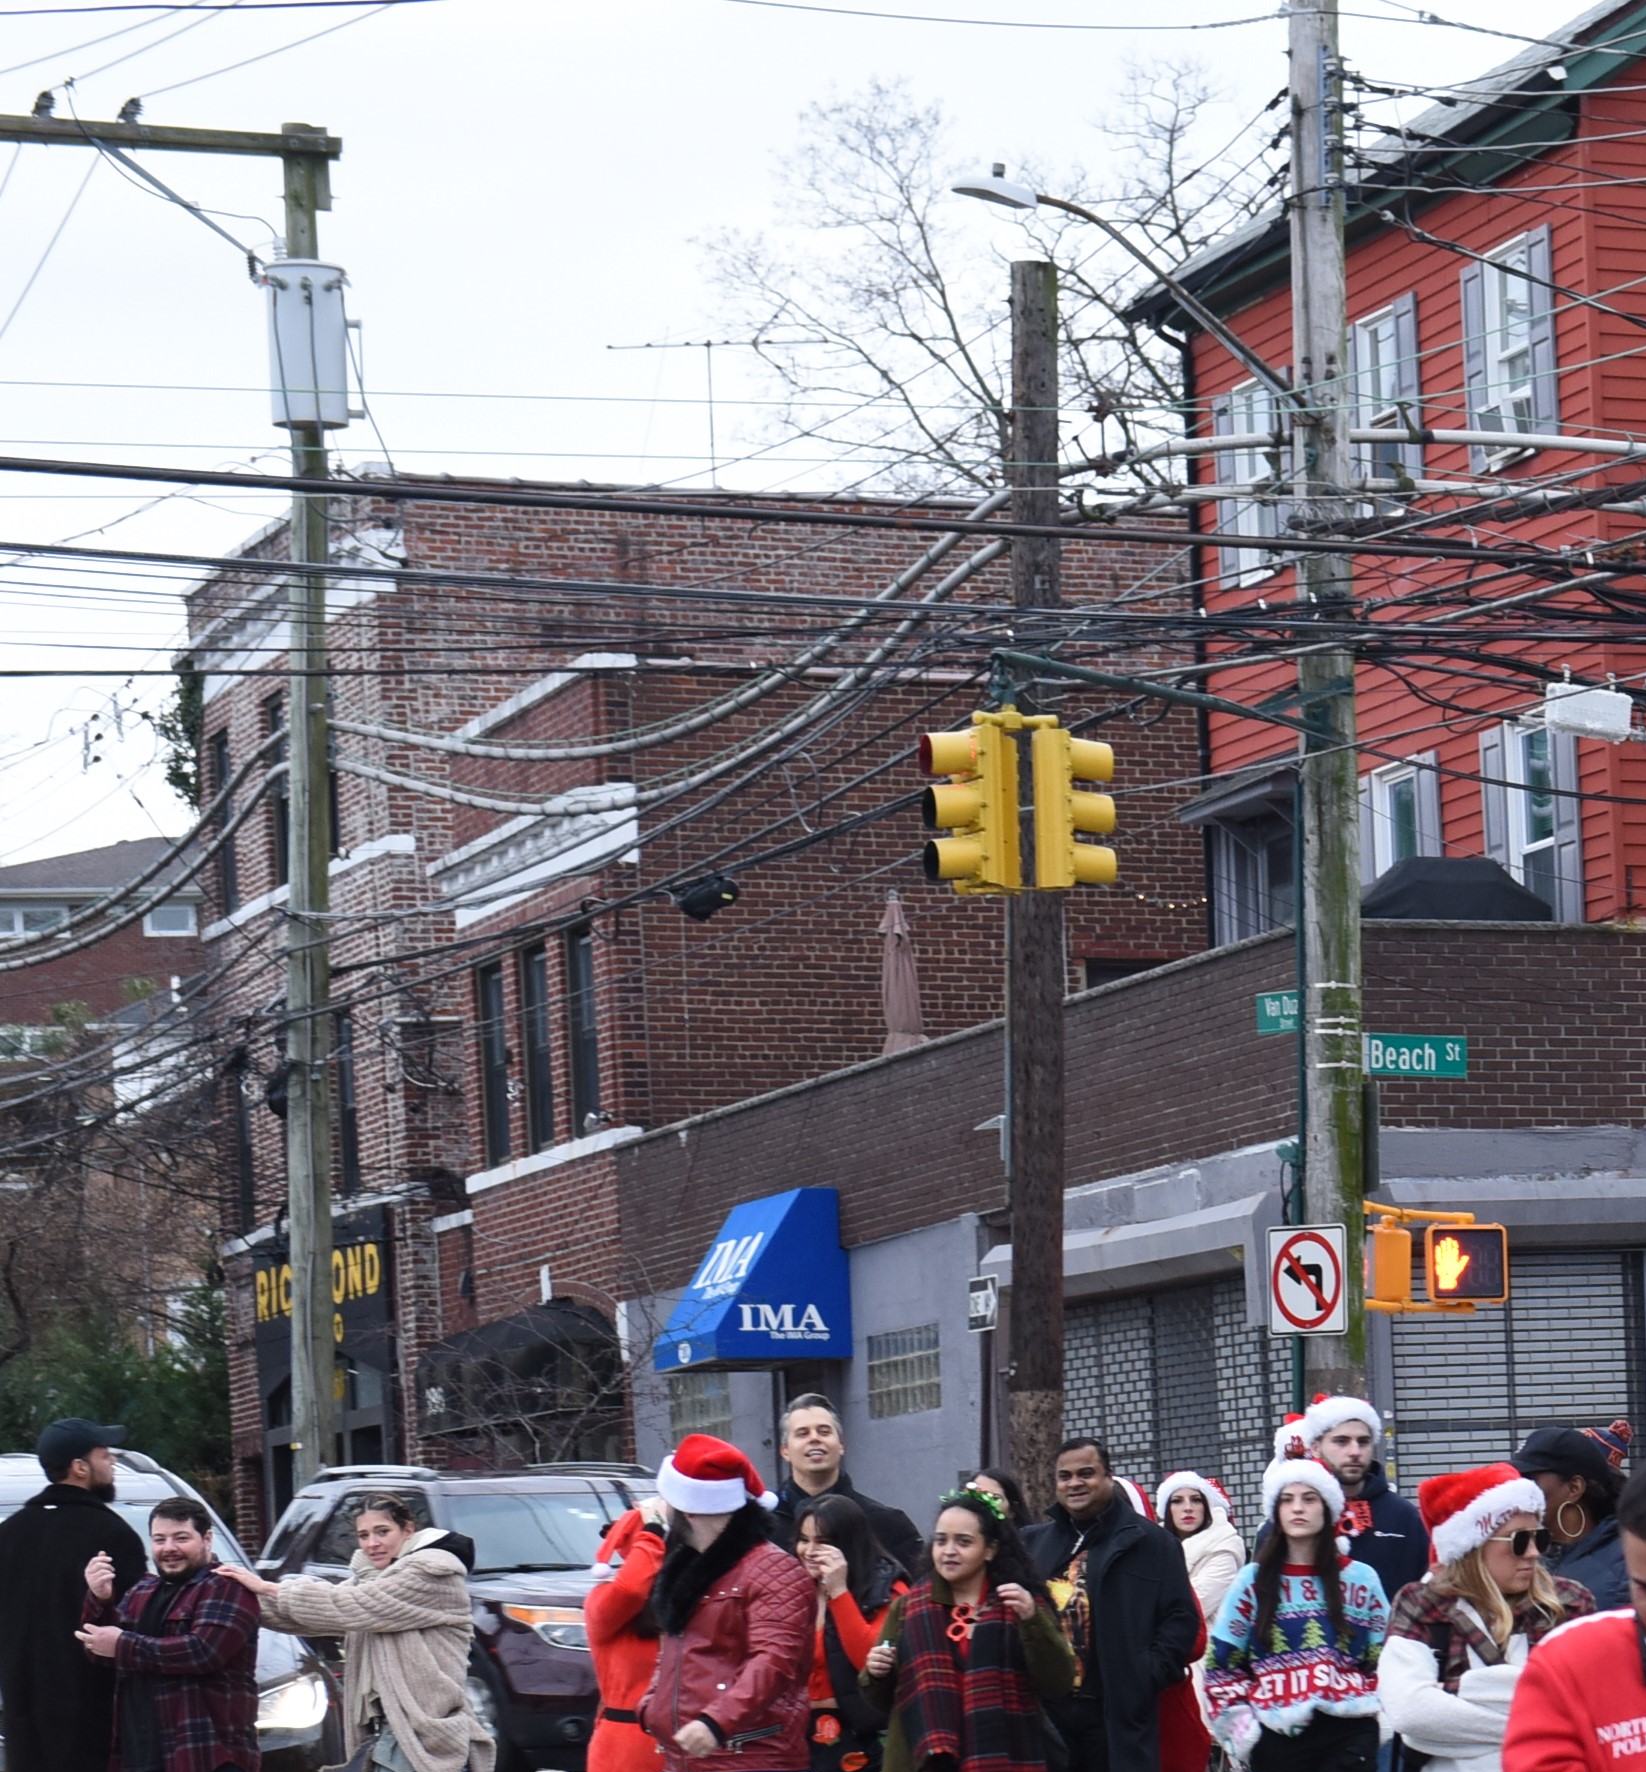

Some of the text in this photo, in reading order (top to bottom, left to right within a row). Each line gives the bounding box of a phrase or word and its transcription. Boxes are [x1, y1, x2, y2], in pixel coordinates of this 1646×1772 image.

[1264, 997, 1280, 1017] Van
[1371, 1039, 1461, 1071] Beach St
[692, 1231, 765, 1290] IMA
[256, 1243, 381, 1323] RICOND
[737, 1303, 831, 1331] IMA
[770, 1331, 786, 1340] The
[1291, 1669, 1310, 1694] IT
